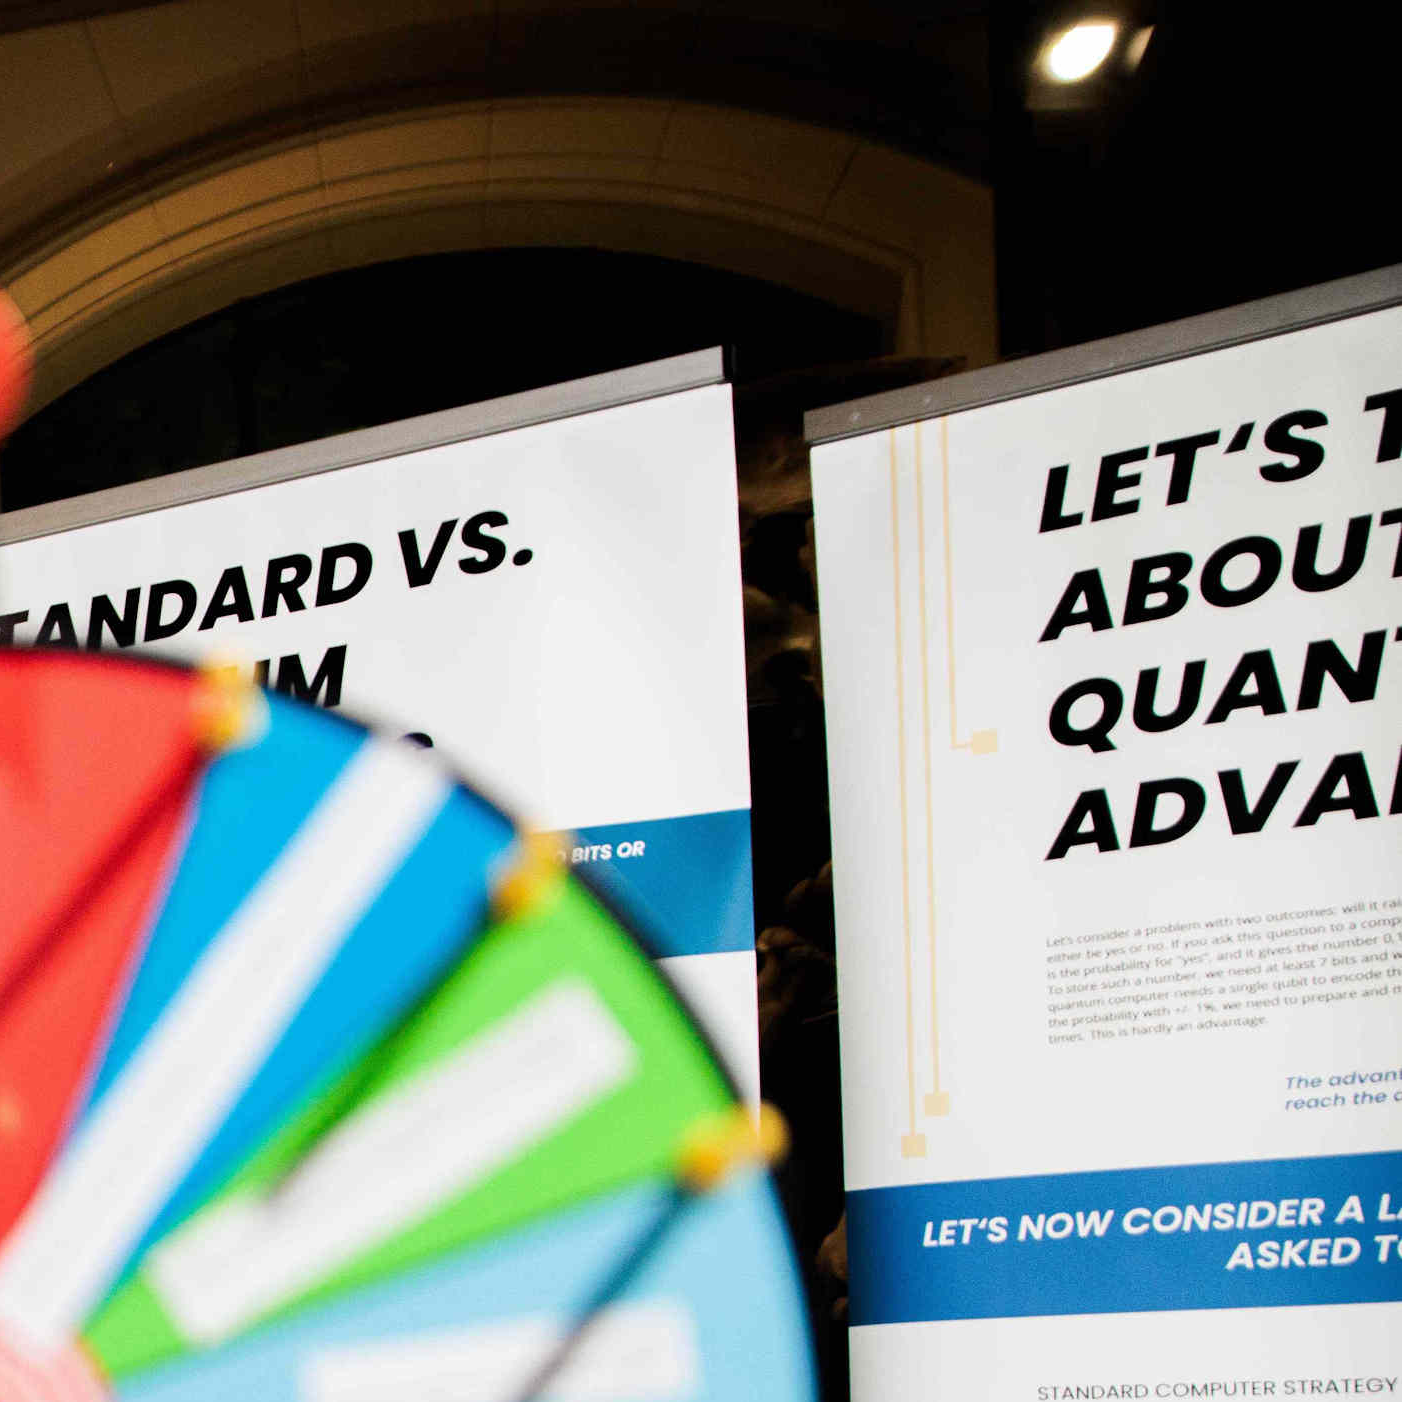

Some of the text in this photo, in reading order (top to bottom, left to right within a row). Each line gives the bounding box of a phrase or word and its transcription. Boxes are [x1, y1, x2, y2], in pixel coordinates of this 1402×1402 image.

[396, 510, 534, 589] VS.
[1048, 629, 1402, 753] QUAN
[1044, 746, 1402, 861] ADVA
[571, 844, 612, 863] BITS
[616, 840, 646, 858] OR
[1047, 950, 1082, 964] either
[1086, 948, 1101, 960] be
[1105, 947, 1125, 959] yes
[1129, 944, 1143, 953] or
[1184, 938, 1207, 950] you
[1211, 933, 1232, 944] ask
[1237, 930, 1261, 942] this
[1266, 923, 1326, 942] question
[1330, 922, 1344, 932] to
[1349, 922, 1357, 930] a
[1077, 929, 1130, 944] consider
[1146, 920, 1201, 936] problem
[1205, 916, 1232, 929] with
[1237, 915, 1262, 926] two
[1342, 902, 1365, 914] will
[1369, 902, 1378, 911] it
[1047, 969, 1056, 979] is
[1060, 967, 1080, 978] the
[1084, 959, 1151, 976] probability
[1155, 956, 1173, 967] for
[1216, 949, 1242, 961] and
[1246, 948, 1254, 958] it
[1259, 944, 1292, 959] gives
[1297, 941, 1319, 952] the
[1323, 935, 1378, 950] number
[1047, 984, 1063, 995] To
[1066, 980, 1097, 994] store
[1101, 977, 1131, 990] such
[1133, 977, 1142, 985] a
[1205, 969, 1223, 978] we
[1228, 964, 1261, 976] need
[1266, 963, 1278, 972] at
[1283, 958, 1315, 971] least
[1320, 957, 1328, 967] 7
[1332, 954, 1357, 966] bits
[1361, 951, 1388, 963] and
[1047, 997, 1105, 1014] quantum
[1109, 991, 1169, 1005] computer
[1173, 985, 1214, 998] needs
[1218, 987, 1226, 995] a
[1229, 981, 1268, 994] single
[1273, 976, 1308, 991] qubit
[1312, 975, 1326, 984] to
[1330, 969, 1382, 984] encode
[1048, 1017, 1068, 1029] the
[1072, 1010, 1139, 1027] probability
[1143, 1005, 1171, 1018] with
[1222, 1001, 1242, 1010] we
[1246, 996, 1280, 1009] need
[1284, 995, 1297, 1005] to
[1302, 988, 1357, 1005] prepare
[1361, 984, 1389, 997] and
[1091, 1028, 1115, 1040] This
[1118, 1026, 1128, 1037] is
[1132, 1021, 1173, 1036] hardly
[1176, 1021, 1193, 1032] an
[1285, 1092, 1346, 1110] reach
[1353, 1091, 1387, 1104] the
[1286, 1075, 1322, 1088] The
[1017, 1209, 1115, 1241] NOW
[1122, 1197, 1326, 1235] CONSIDER
[1334, 1195, 1365, 1224] A
[1225, 1236, 1361, 1271] ASKED
[1037, 1376, 1399, 1401] STANDARD COMPUTER STRATEGY
